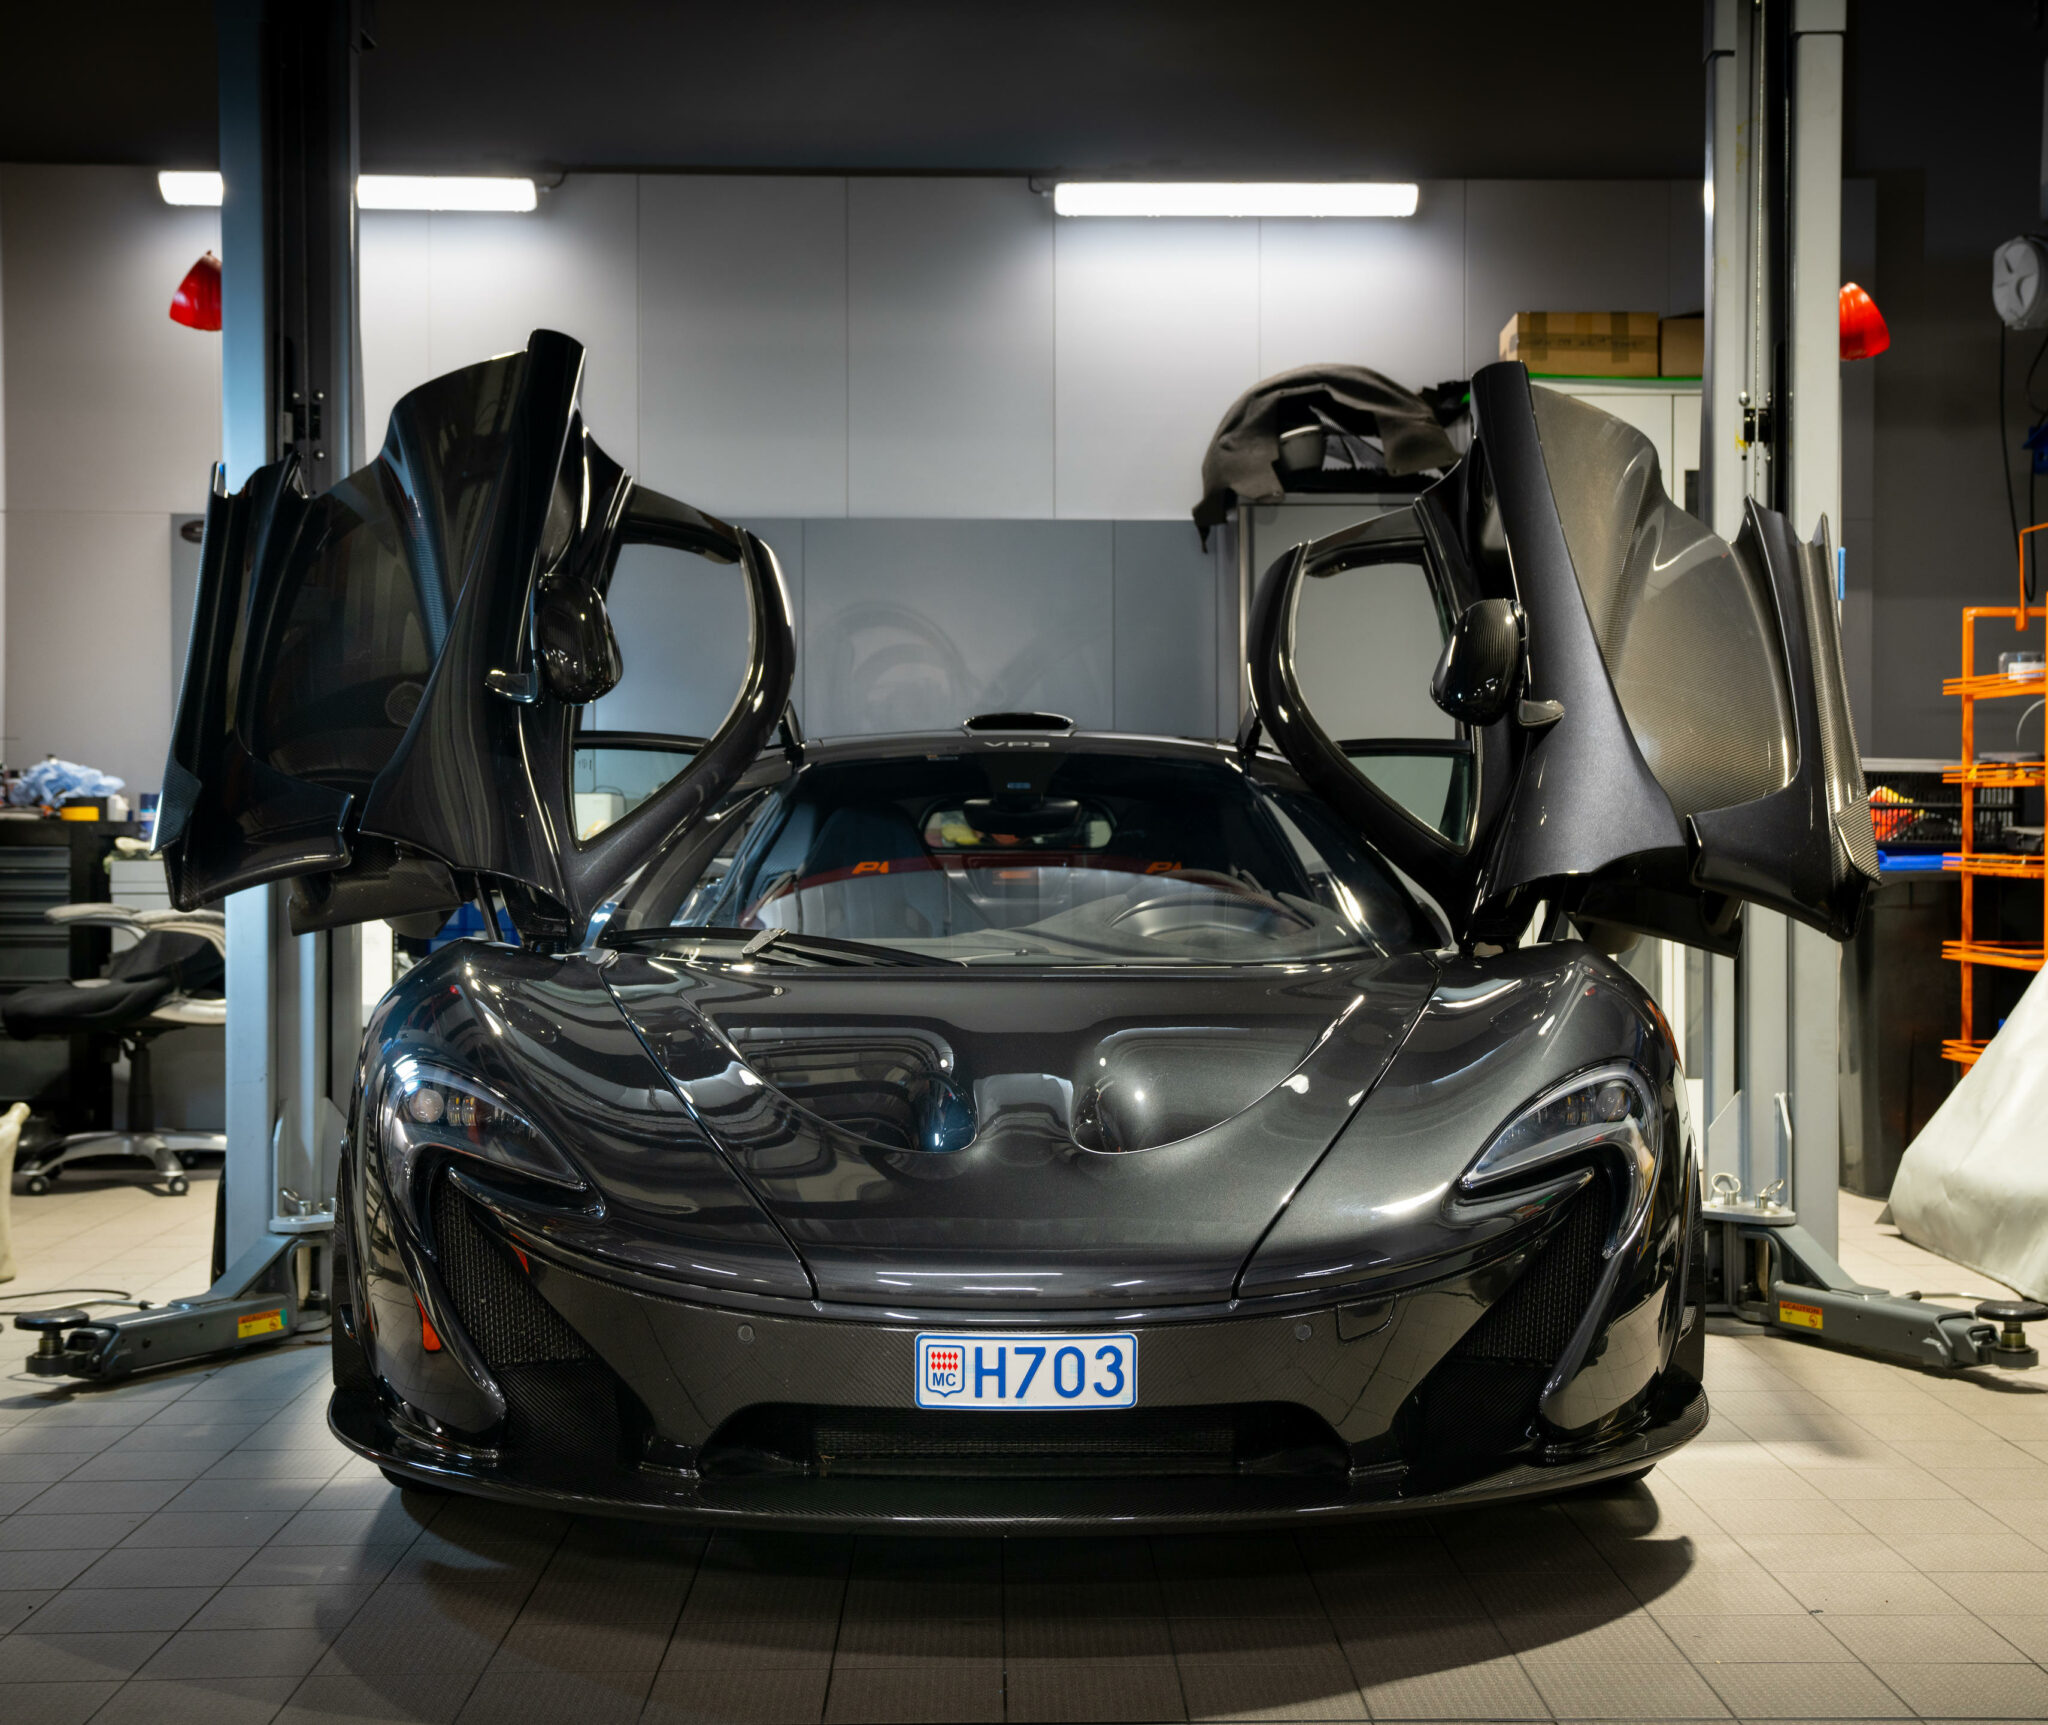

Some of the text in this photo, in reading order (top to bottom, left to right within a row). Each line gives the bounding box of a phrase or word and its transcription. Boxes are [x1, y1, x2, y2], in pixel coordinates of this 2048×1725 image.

[1786, 1303, 1820, 1315] CAUTION
[932, 1345, 1125, 1399] MC H703
